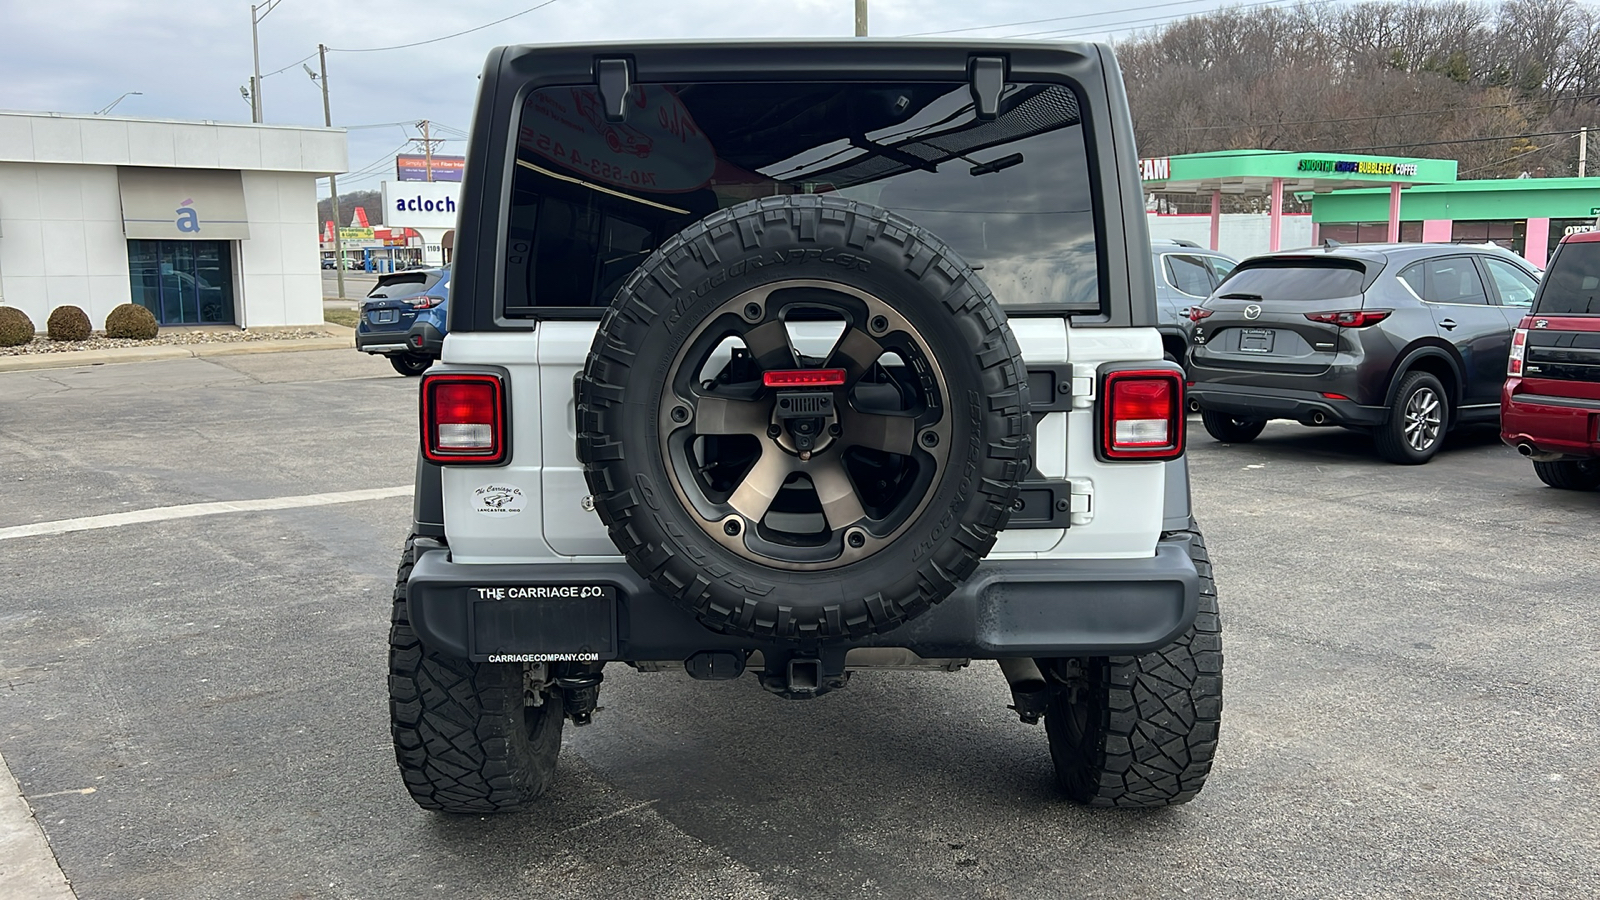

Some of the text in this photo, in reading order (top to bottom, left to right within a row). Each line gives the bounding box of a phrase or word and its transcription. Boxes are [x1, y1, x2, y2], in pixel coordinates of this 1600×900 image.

[1395, 163, 1418, 175] COFFEE
[426, 244, 441, 253] 1109
[475, 487, 486, 496] The
[486, 485, 513, 493] Carriage
[477, 586, 605, 599] THE CARRIAGE CO.
[488, 653, 599, 663] CARRIAGECOMPANY.COM
